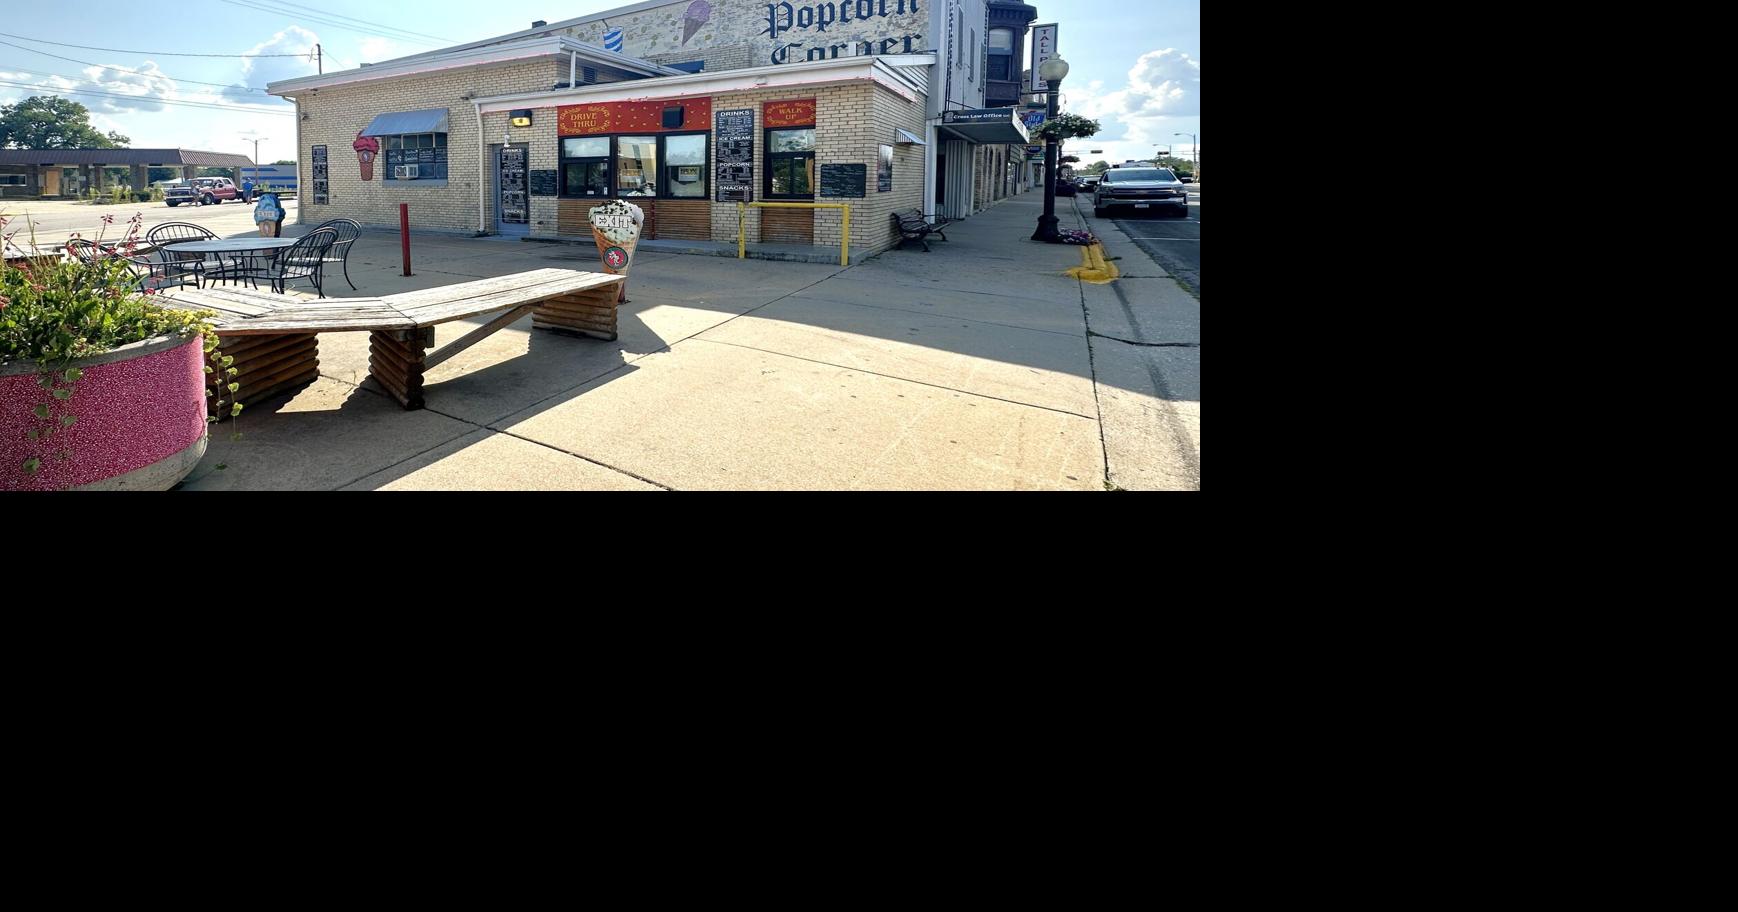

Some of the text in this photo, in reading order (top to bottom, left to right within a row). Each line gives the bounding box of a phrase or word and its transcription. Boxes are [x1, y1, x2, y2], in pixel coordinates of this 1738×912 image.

[760, 0, 919, 39] Popcorn
[771, 34, 922, 64] Corner
[570, 112, 597, 121] DRIVE
[573, 120, 597, 128] THRU
[594, 214, 631, 228] EXIT
